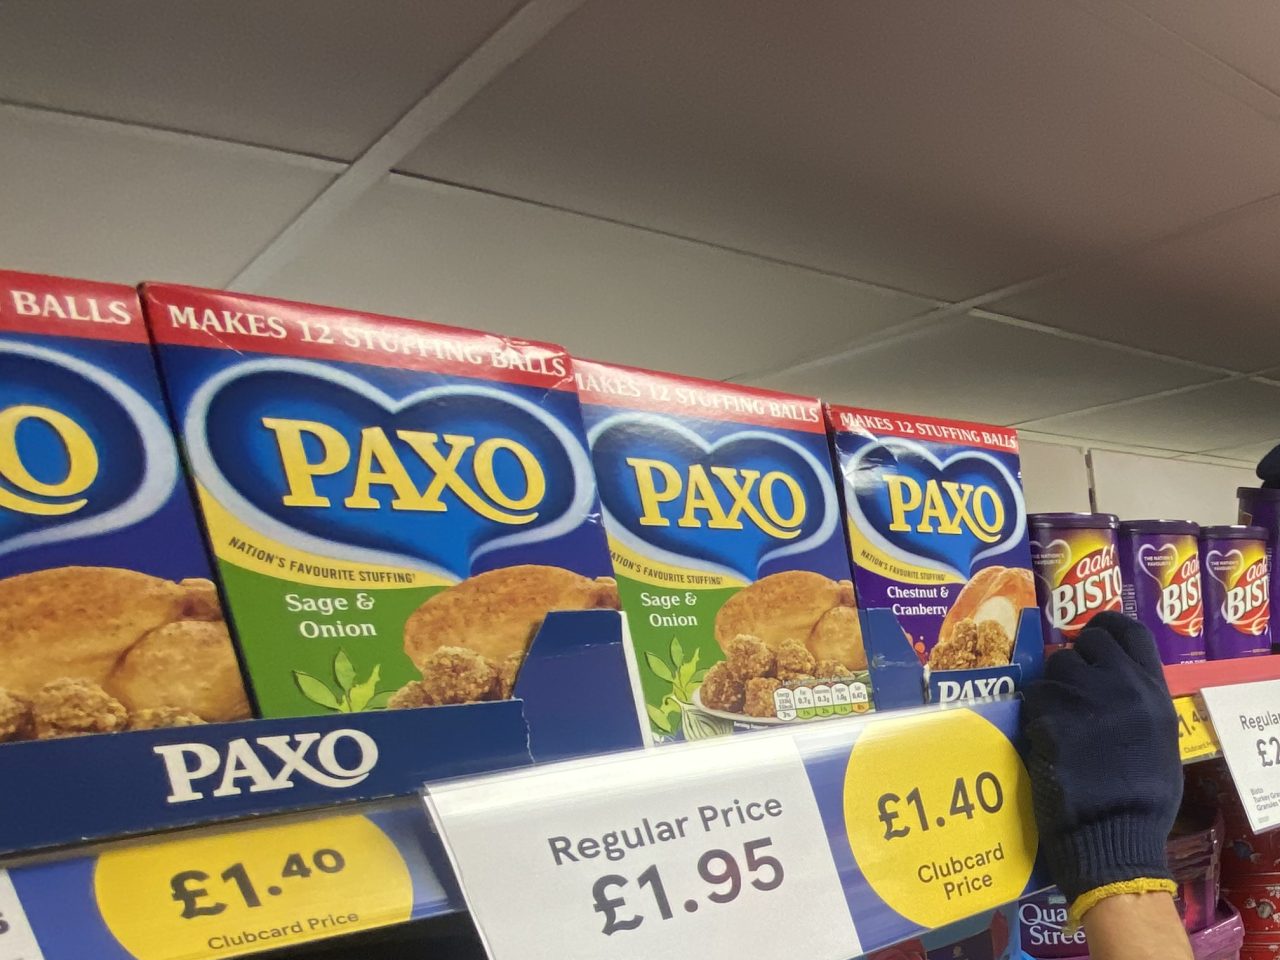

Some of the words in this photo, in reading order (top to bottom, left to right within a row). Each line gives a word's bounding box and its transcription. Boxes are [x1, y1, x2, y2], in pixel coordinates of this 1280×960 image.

[11, 290, 131, 325] BALLS
[167, 304, 287, 339] MAKES
[301, 320, 333, 344] 12
[343, 327, 483, 366] STUFFING
[491, 348, 567, 378] BALLS
[650, 386, 672, 402] 12
[675, 387, 765, 415] STUFFING
[770, 401, 820, 423] BALLS
[840, 412, 894, 431] MAKES
[897, 420, 915, 434] 12
[917, 423, 980, 442] STUFFING
[983, 432, 1017, 449] BALLS
[261, 416, 546, 525] PAXO
[626, 457, 806, 539] PAXO
[882, 474, 1005, 544] PAXO
[228, 536, 286, 569] NATION'S
[289, 559, 355, 582] FAVOURITE
[643, 566, 686, 584] FAVOURITE
[860, 549, 889, 571] NATION'S
[889, 564, 919, 580] FAVOURITE
[1076, 543, 1115, 578] aah!
[285, 592, 349, 614] Sage
[356, 592, 375, 611] &
[640, 592, 681, 609] Sage
[685, 592, 697, 606] &
[886, 585, 938, 598] Chestnut
[940, 586, 949, 598] &
[1052, 565, 1123, 629] BISTO
[648, 612, 698, 629] Onion
[892, 603, 948, 618] Cranberry
[299, 619, 377, 639] Onion
[937, 676, 1015, 703] PAXO
[153, 728, 379, 804] PAXO
[877, 770, 1006, 843] £1.40
[1253, 793, 1269, 804] Turkey
[1256, 800, 1278, 811] Granules
[547, 812, 690, 867] Regular
[697, 796, 784, 841] Price
[917, 842, 1005, 886] Clubcard
[170, 847, 347, 920] £1.40
[591, 836, 785, 936] £1.95
[944, 872, 993, 901] Price
[207, 920, 303, 951] Clubcard
[307, 908, 360, 934] Price
[1029, 924, 1087, 946] Stree
